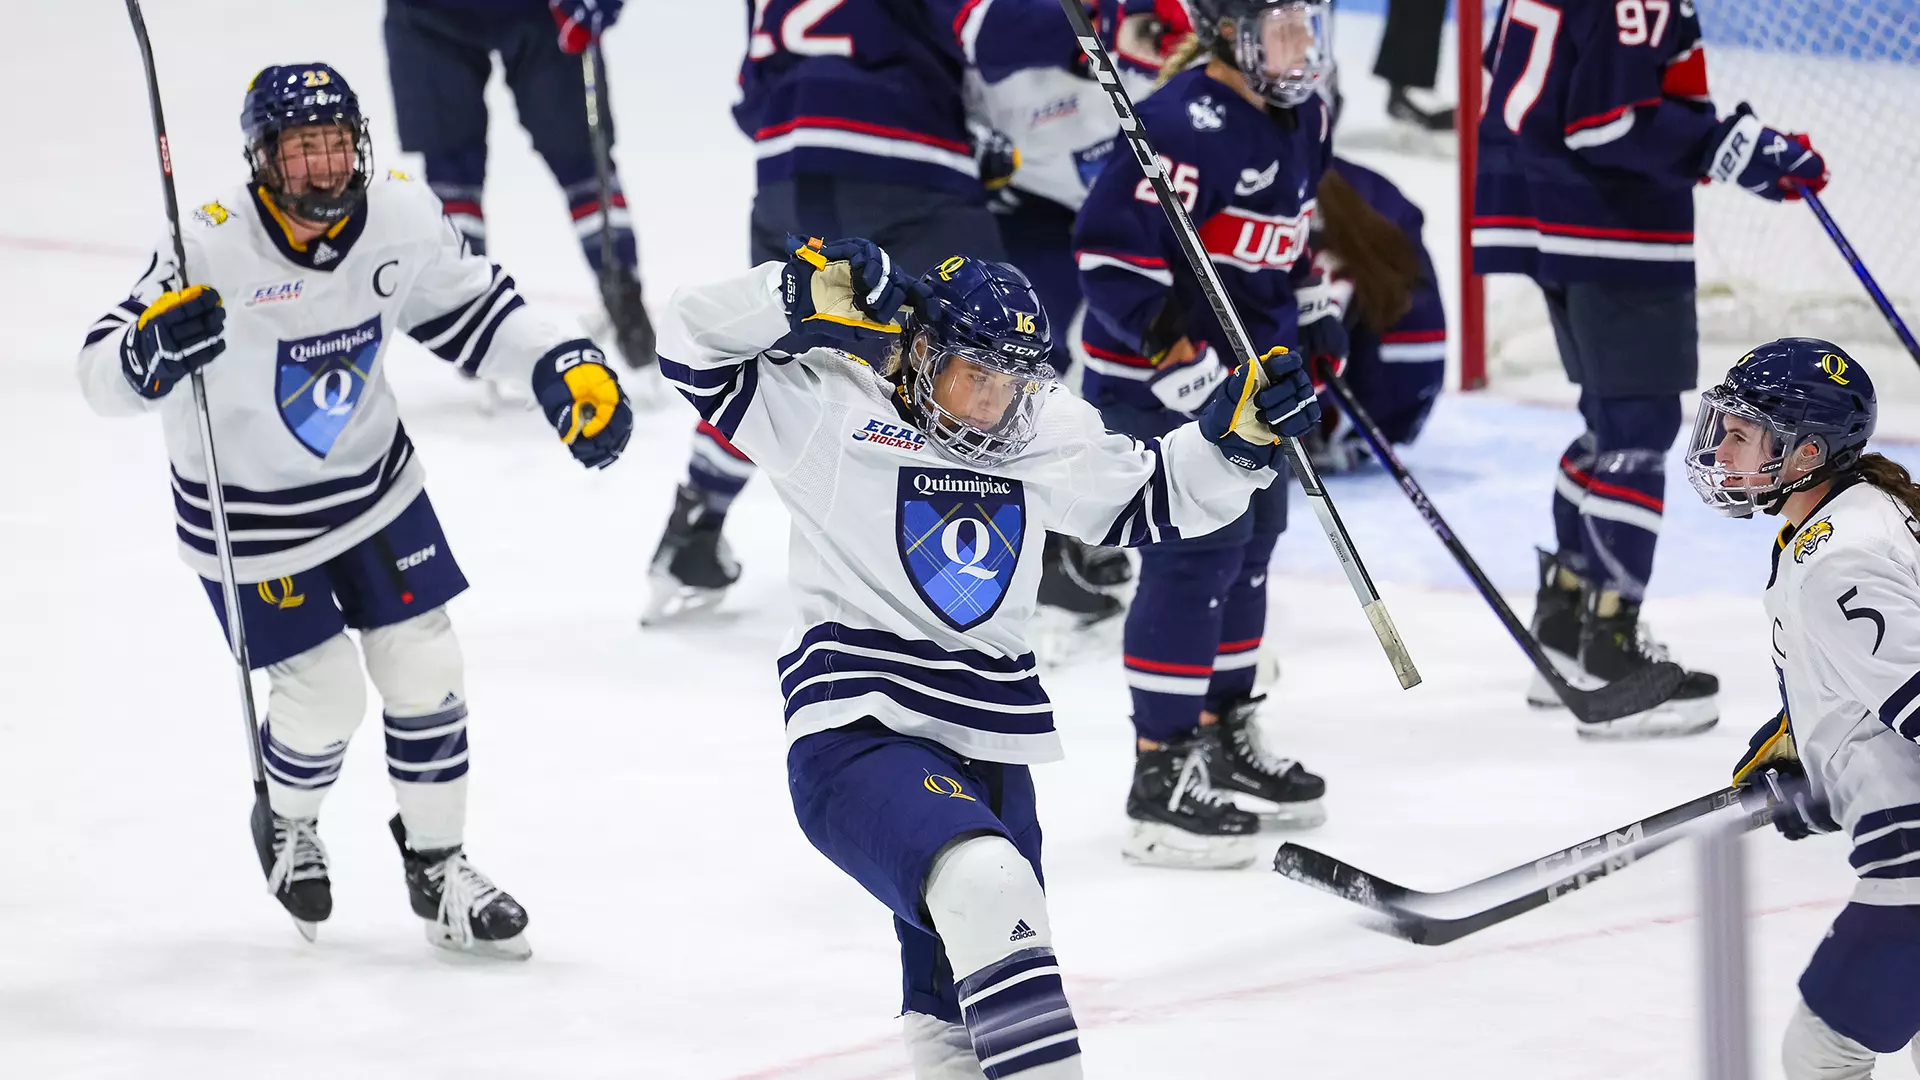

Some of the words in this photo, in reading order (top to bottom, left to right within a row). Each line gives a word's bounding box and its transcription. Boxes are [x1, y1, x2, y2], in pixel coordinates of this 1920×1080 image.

[1616, 0, 1669, 47] 97
[302, 70, 331, 87] 23
[1077, 36, 1160, 178] CCM
[373, 260, 399, 297] C
[939, 256, 966, 281] Q
[1014, 312, 1036, 334] 16
[290, 326, 375, 362] Quinnipiac
[1002, 342, 1041, 358] CCM
[1821, 353, 1850, 386] Q
[313, 369, 353, 416] Q
[863, 419, 927, 445] ECAC
[868, 433, 925, 452] HOCKEY
[1761, 462, 1782, 472] CCM
[913, 473, 1011, 498] Quinnipiac
[1782, 474, 1813, 494] CCM
[941, 517, 999, 580] Q
[1836, 585, 1886, 656] 5
[922, 768, 977, 801] Q
[1009, 929, 1037, 942] adidas
